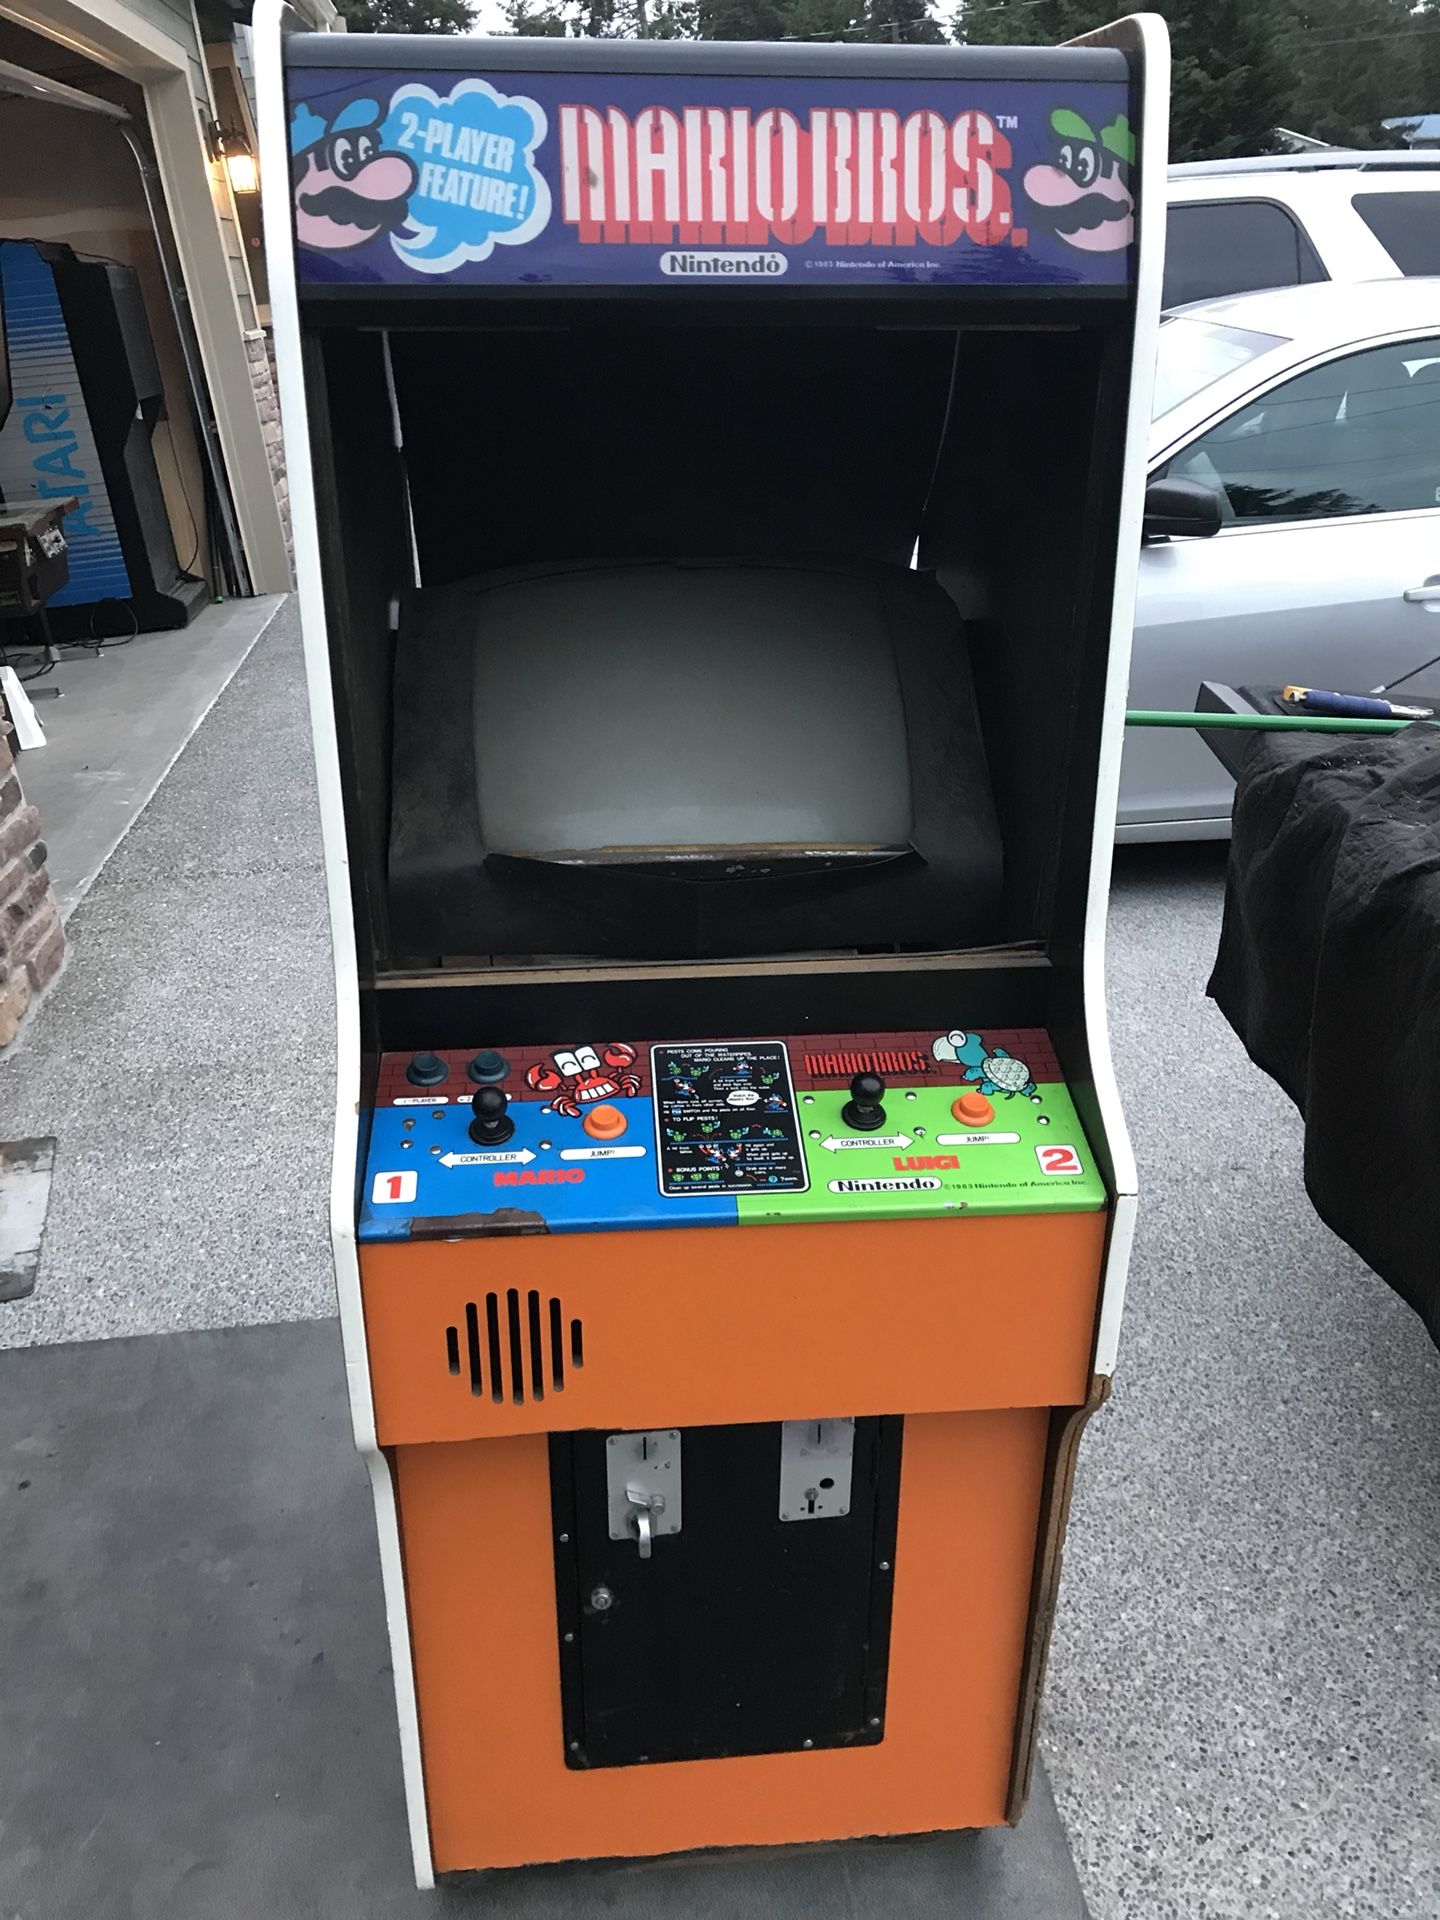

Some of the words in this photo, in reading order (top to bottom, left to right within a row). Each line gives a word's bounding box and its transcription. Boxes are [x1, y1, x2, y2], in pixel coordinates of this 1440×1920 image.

[397, 111, 515, 173] 2-PLAYER
[559, 104, 801, 226] MARIO
[809, 106, 1012, 226] BROS.
[418, 161, 530, 220] FEATURE!
[668, 253, 782, 273] Nintendo
[835, 260, 876, 269] Nintendo
[877, 260, 886, 269] of
[887, 260, 925, 269] America
[16, 394, 101, 537] ATARI
[804, 1052, 872, 1074] MARIO
[840, 1138, 895, 1148] CONTROLLER
[460, 1153, 517, 1163] CONTROLLER
[893, 1155, 960, 1171] LUIGI
[1042, 1149, 1078, 1171] 2
[386, 1176, 402, 1199] 1
[494, 1168, 586, 1187] MARIO
[838, 1178, 936, 1192] Nintendo
[974, 1182, 1017, 1190] Nintendo
